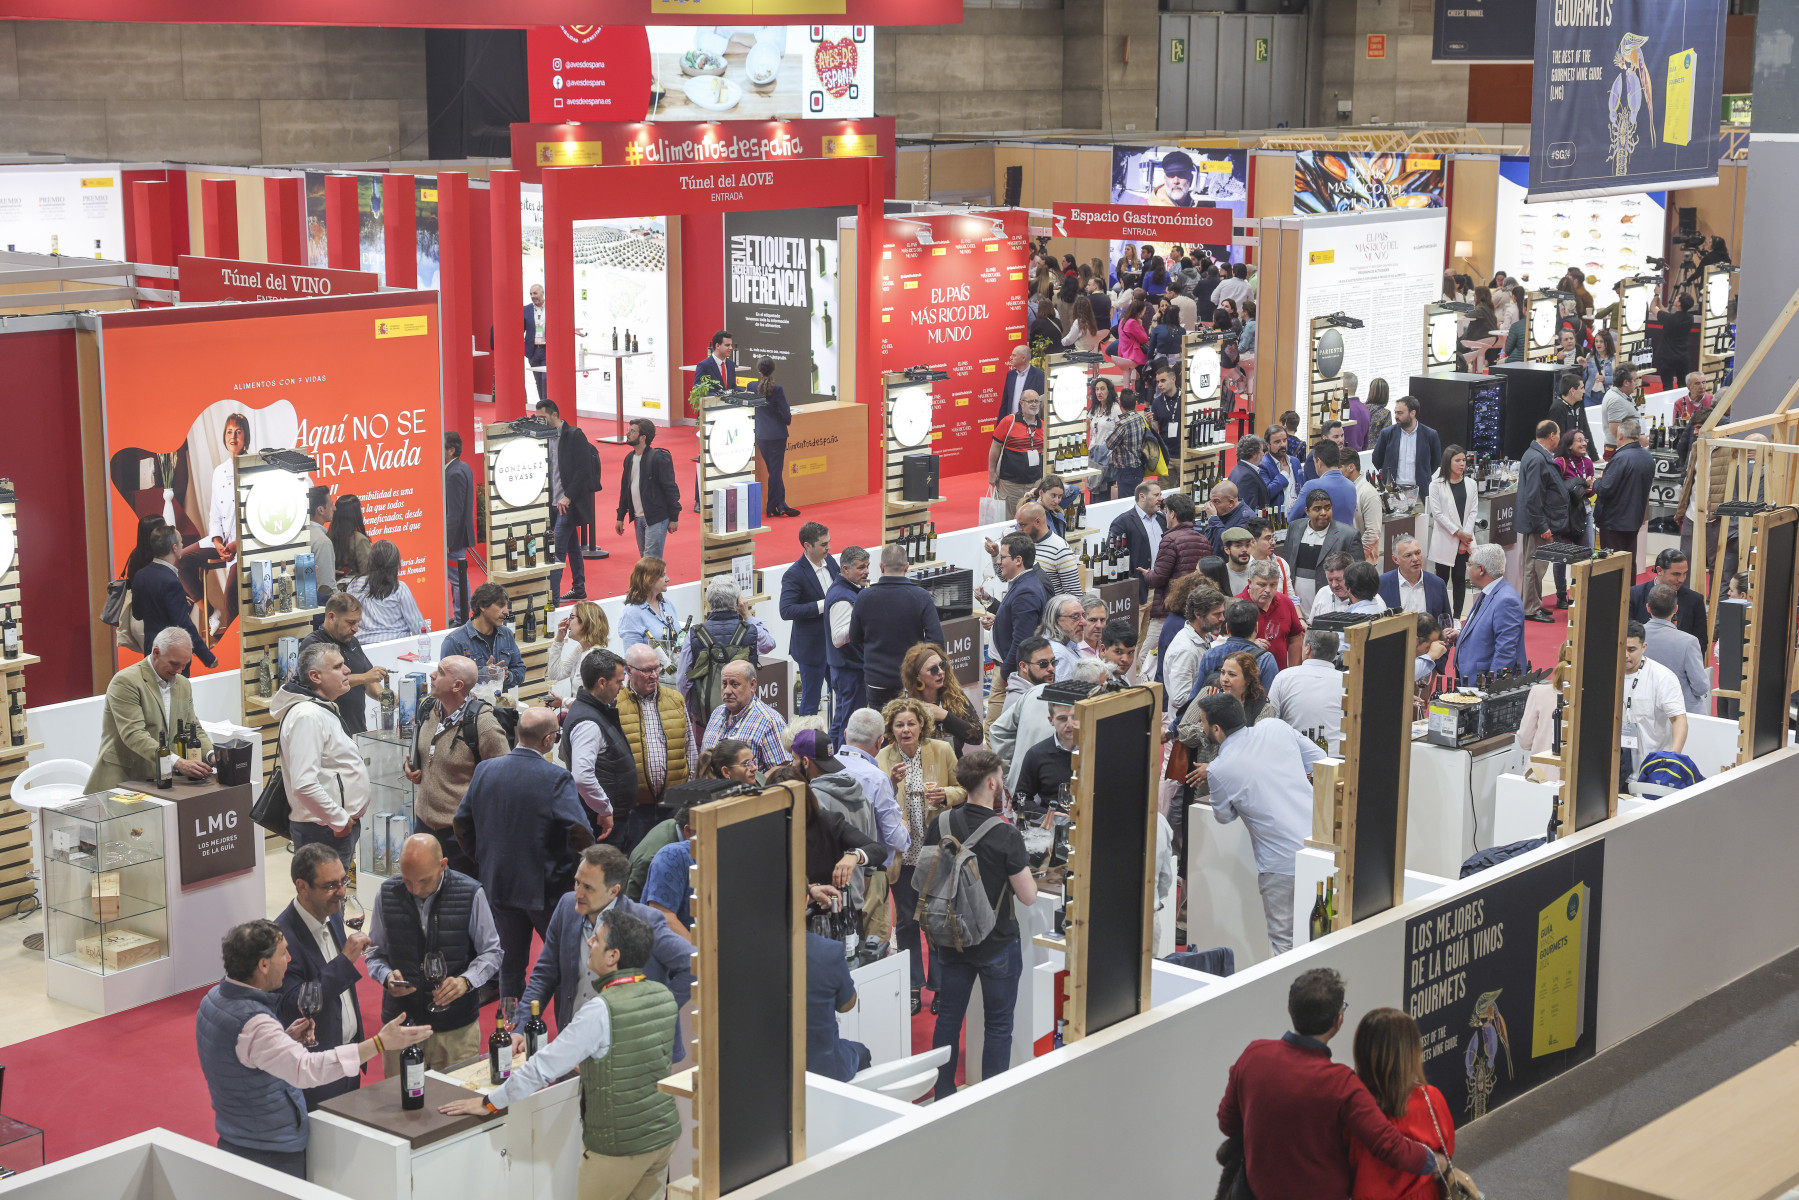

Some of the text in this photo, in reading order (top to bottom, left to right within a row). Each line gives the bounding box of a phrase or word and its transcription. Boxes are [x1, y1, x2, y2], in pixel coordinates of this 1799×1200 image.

[1554, 0, 1613, 27] GOURMETS
[819, 45, 854, 69] AVES DE
[1552, 49, 1591, 64] THE BEST OF THE
[1551, 66, 1603, 82] GOURMETS WINE GUIDE
[1550, 84, 1564, 101] (LMG)
[625, 134, 803, 166] #alimentosdespaña
[680, 171, 774, 190] Túnel del AOVE
[82, 194, 108, 202] PREMIO
[711, 191, 743, 202] ENTRADA
[1070, 208, 1213, 227] Espacio Gastronómico
[1122, 227, 1157, 237] ENTRADA
[731, 235, 746, 249] LA
[731, 250, 746, 265] EN
[745, 235, 807, 272] ETIQUETA
[221, 268, 332, 295] Túnel del VINO
[731, 269, 808, 307] DIFERENCIA
[931, 283, 970, 304] EL PAÍS
[910, 304, 990, 326] MÁS RICO DEL
[927, 325, 972, 345] MUNDO
[233, 379, 276, 391] ALIMENTOS
[278, 377, 296, 386] CON
[304, 374, 327, 383] VIDAS
[291, 408, 427, 454] Aquí NO SE
[785, 435, 839, 451] limentosdespaña
[360, 438, 422, 473] Nada
[508, 472, 534, 482] BYASS
[392, 489, 400, 497] es
[400, 487, 414, 496] una
[366, 500, 405, 514] la que todos
[1497, 506, 1513, 521] LMG
[273, 519, 283, 532] N
[363, 508, 423, 526] beneficiados, desde
[383, 524, 401, 534] hasta
[403, 522, 408, 531] el
[409, 522, 421, 532] que
[414, 556, 427, 565] José
[1109, 597, 1131, 615] LMG
[946, 636, 972, 655] LMG
[758, 681, 778, 700] MG
[195, 810, 238, 837] LMG
[198, 834, 238, 850] LOS MEJORES
[202, 843, 235, 857] DE LA GUÍA
[1412, 898, 1485, 954] LOS MEJORES
[1540, 922, 1553, 939] GUÍA
[1411, 922, 1504, 989] DE LA GUÍA VINOS
[1539, 936, 1568, 960] GOURMETS
[1410, 971, 1467, 1021] GOURMETS
[1420, 1025, 1446, 1048] EST OF THE
[1433, 1041, 1444, 1058] WINE
[1445, 1034, 1459, 1051] GUIDE
